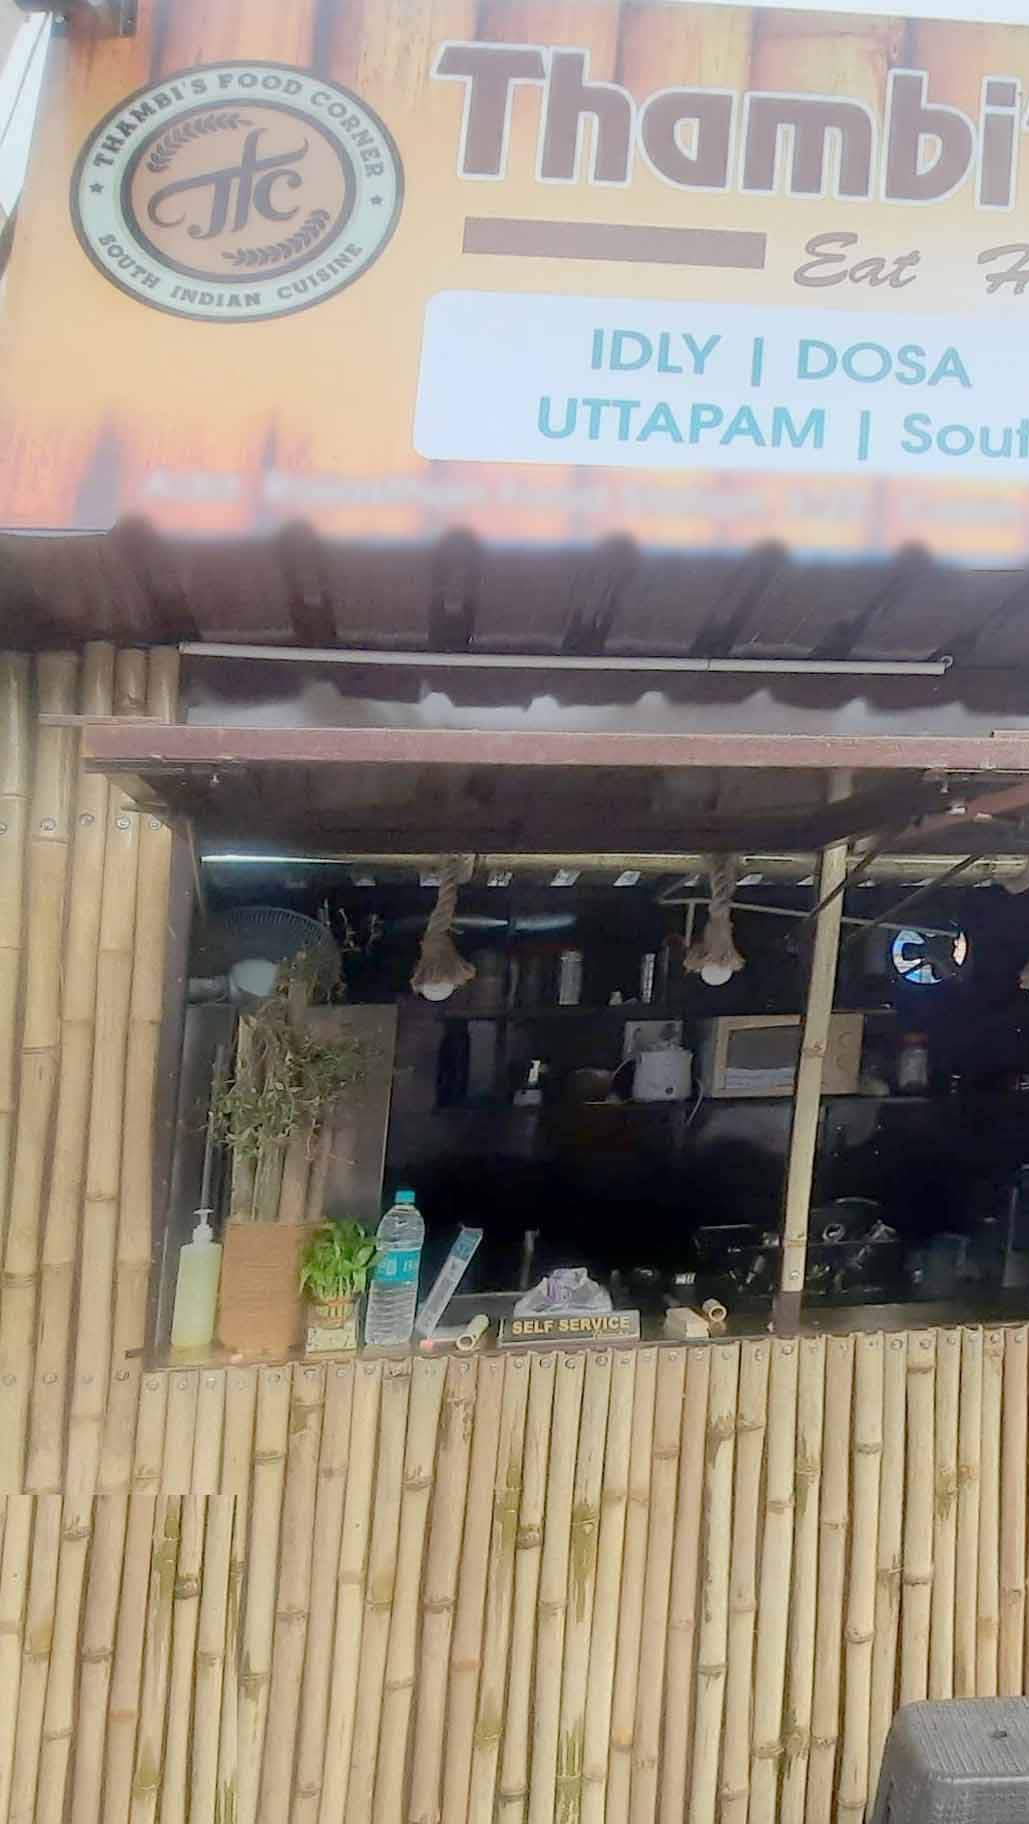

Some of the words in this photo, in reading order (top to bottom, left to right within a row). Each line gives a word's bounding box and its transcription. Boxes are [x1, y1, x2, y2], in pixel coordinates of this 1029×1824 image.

[94, 73, 208, 168] THAMBI'S
[217, 72, 303, 96] FOOD
[309, 90, 385, 178] CORNER
[98, 233, 161, 289] SOUTH
[169, 285, 262, 308] INDIAN
[276, 243, 363, 300] CUISINE
[793, 232, 921, 288] Eat
[590, 328, 721, 375] IDLY
[797, 339, 972, 389] DOSA
[537, 396, 826, 449] UTTAPAM
[512, 1319, 553, 1335] SELF
[559, 1315, 630, 1333] SERVICE
